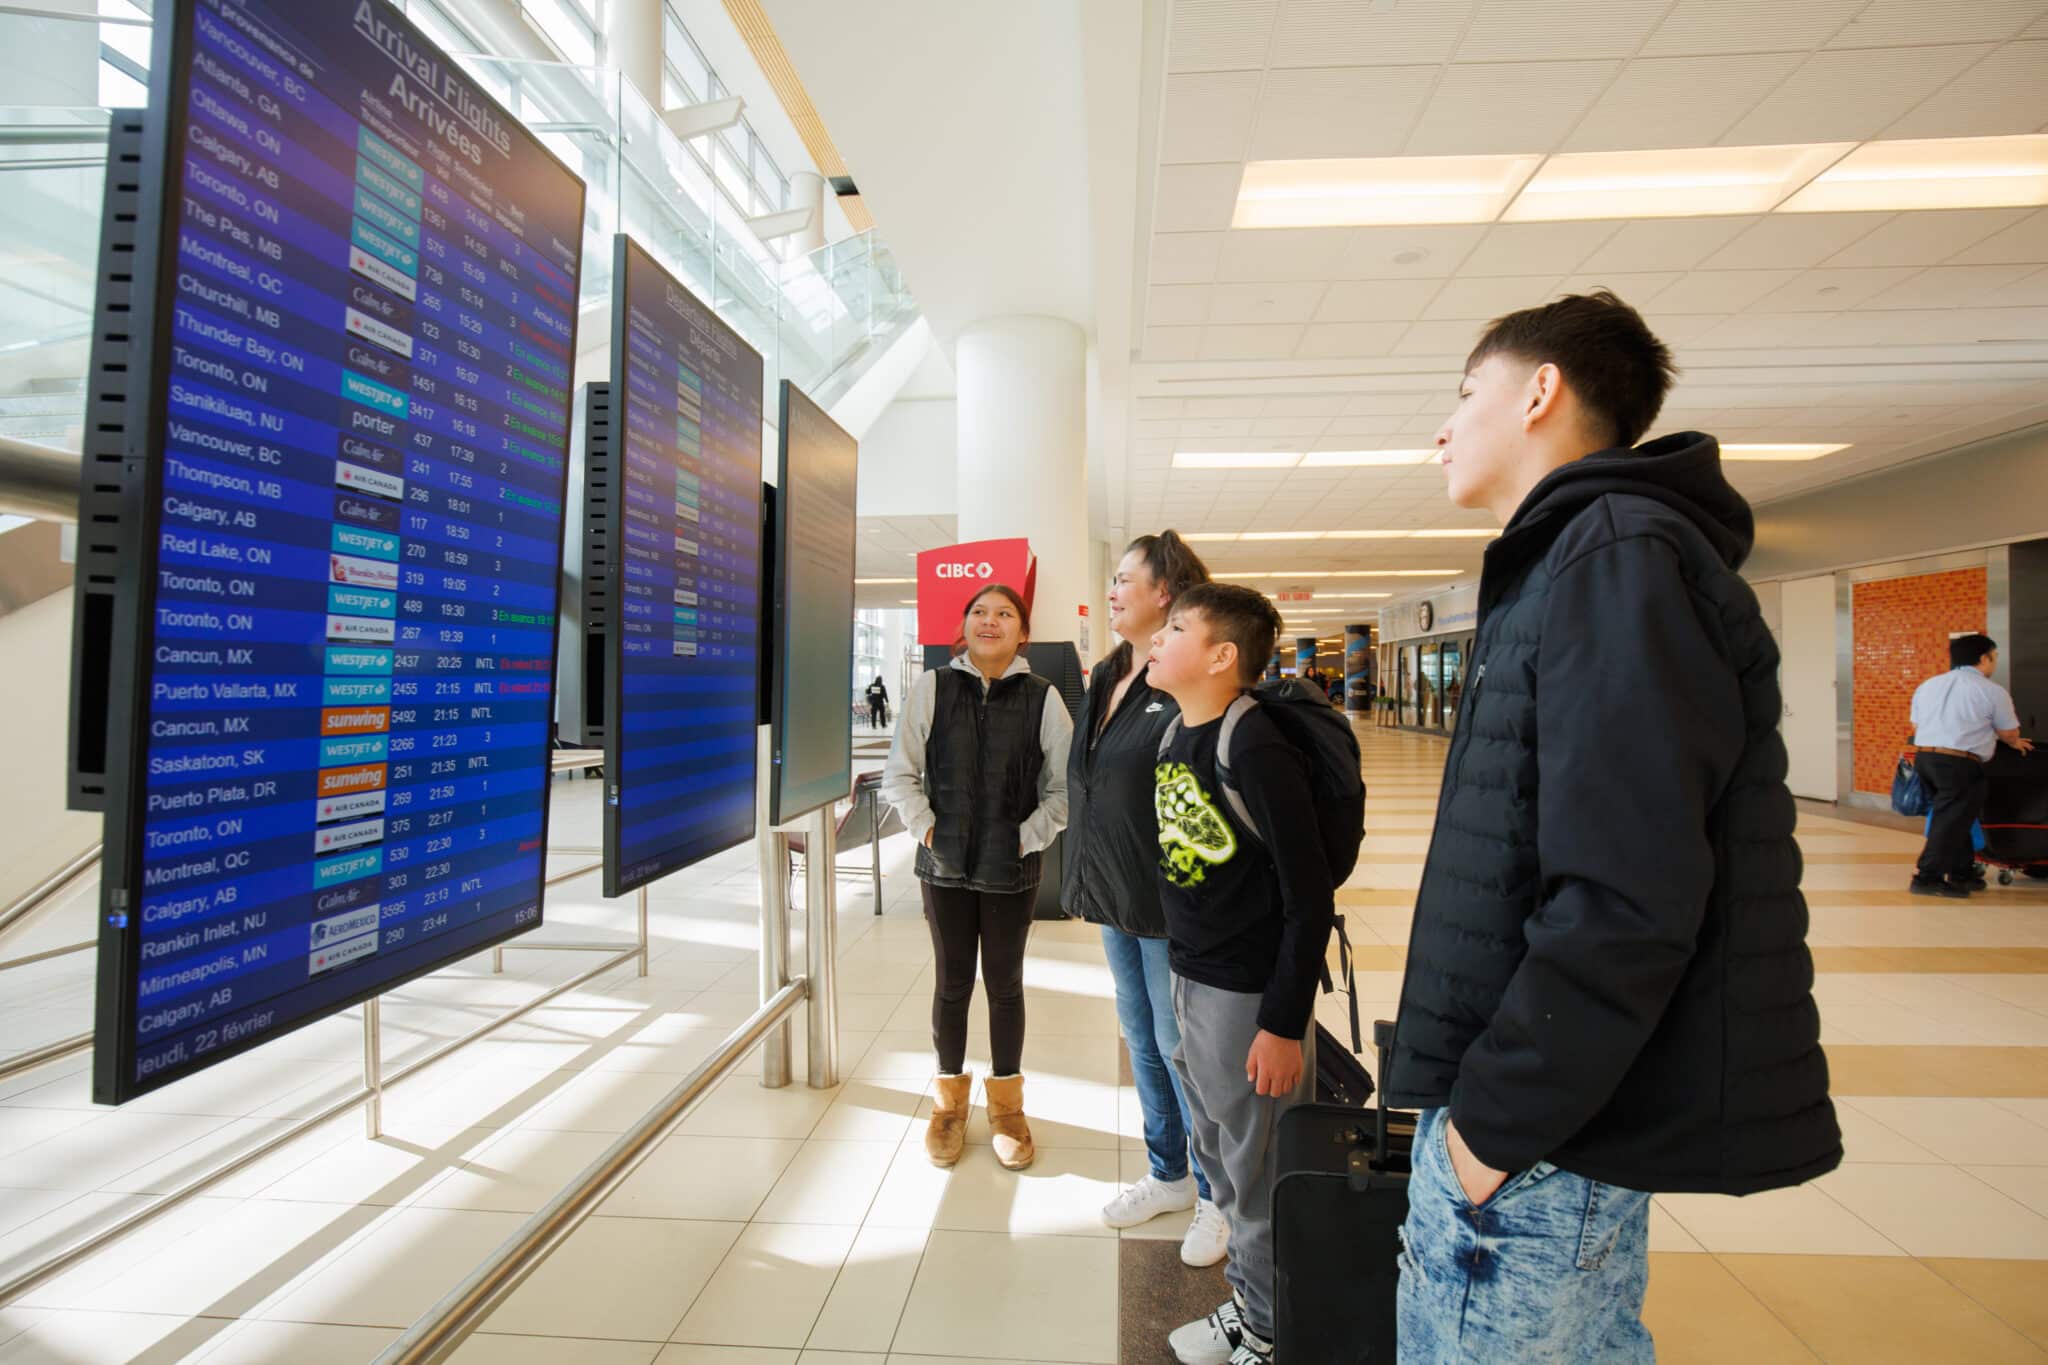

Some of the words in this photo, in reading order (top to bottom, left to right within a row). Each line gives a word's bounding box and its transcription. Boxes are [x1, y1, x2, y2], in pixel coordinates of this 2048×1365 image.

[354, 0, 437, 87] Arrival
[443, 73, 510, 152] Flights
[194, 52, 252, 103] Atlanta,
[258, 94, 281, 120] GA
[284, 76, 306, 101] BC
[192, 89, 252, 139] Ottawa,
[256, 130, 280, 155] ON
[389, 73, 481, 165] Arrivées
[189, 125, 252, 176] Calgary,
[256, 166, 279, 188] AB
[186, 160, 250, 210] Toronto,
[254, 200, 279, 224] ON
[184, 197, 216, 227] The
[220, 217, 254, 248] Pas,
[258, 236, 282, 260] MB
[182, 236, 254, 284] Montreal,
[258, 273, 283, 294] QC
[178, 274, 252, 318] Churchill,
[256, 306, 280, 328] MB
[176, 309, 242, 348] Thunder
[246, 337, 277, 364] Bay,
[281, 352, 304, 371] ON
[422, 322, 440, 339] 123
[420, 349, 437, 366] 371
[174, 346, 238, 384] Toronto,
[242, 372, 267, 392] ON
[413, 375, 435, 394] 1451
[171, 385, 256, 426] Sanikiluaq,
[260, 413, 284, 432] NU
[410, 402, 434, 420] 3417
[352, 411, 395, 435] porter
[168, 422, 254, 460] Vancouver,
[259, 447, 282, 464] BC
[414, 432, 432, 448] 437
[412, 460, 430, 476] 241
[166, 458, 254, 495] Thompson,
[258, 481, 282, 498] MB
[164, 497, 230, 526] Calgary,
[234, 511, 256, 528] AB
[410, 516, 428, 530] 117
[162, 534, 196, 554] Red
[202, 540, 242, 562] Lake,
[247, 548, 271, 564] ON
[338, 532, 383, 551] WESTJET
[408, 544, 426, 558] 270
[405, 572, 424, 585] 319
[936, 564, 974, 578] CIBC
[160, 571, 225, 596] Toronto,
[230, 580, 254, 596] ON
[334, 592, 380, 609] WESTJET
[158, 608, 223, 630] Toronto,
[228, 615, 252, 630] ON
[360, 626, 389, 634] CANADA
[402, 627, 421, 640] 267
[156, 647, 223, 665] Cancun,
[228, 650, 253, 664] MX
[330, 654, 376, 668] WESTJET
[394, 656, 419, 667] 2437
[437, 656, 462, 668] 20:25
[154, 683, 208, 699] Puerto
[213, 684, 270, 699] Vallarta,
[274, 684, 296, 697] MX
[329, 684, 374, 698] WESTJET
[393, 683, 418, 696] 2455
[436, 683, 460, 695] 21:15
[328, 710, 385, 729] sunwing
[392, 711, 416, 724] 5492
[434, 708, 459, 721] 21:15
[152, 720, 219, 736] Cancun,
[224, 718, 249, 732] MX
[327, 742, 371, 757] WESTJET
[390, 738, 414, 751] 3266
[150, 754, 238, 774] Saskatoon,
[243, 750, 265, 765] SK
[324, 768, 382, 789] sunwing
[394, 766, 412, 779] 251
[148, 794, 203, 811] Puerto
[208, 788, 248, 803] Plata,
[254, 782, 276, 797] DR
[430, 786, 454, 800] 21:50
[335, 804, 348, 812] AIR
[350, 800, 379, 810] CANADA
[392, 819, 410, 834] 375
[428, 811, 454, 827] 22:17
[147, 826, 212, 848] Toronto,
[217, 819, 243, 836] ON
[334, 833, 348, 842] AIR
[349, 828, 378, 840] CANADA
[145, 858, 220, 886] Montreal,
[225, 851, 249, 869] QC
[320, 859, 364, 878] WESTJET
[144, 895, 210, 922] Calgary,
[214, 887, 237, 906] AB
[423, 914, 448, 931] 23:44
[142, 934, 199, 960] Rankin
[204, 924, 240, 942] Inlet,
[244, 912, 266, 930] NU
[386, 928, 404, 944] 290
[140, 955, 239, 996] Minneapolis,
[243, 944, 268, 963] MN
[139, 1001, 205, 1032] Calgary,
[210, 988, 232, 1008] AB
[136, 1041, 189, 1082] jeudi,
[195, 1030, 217, 1053] 22
[222, 1010, 274, 1042] février
